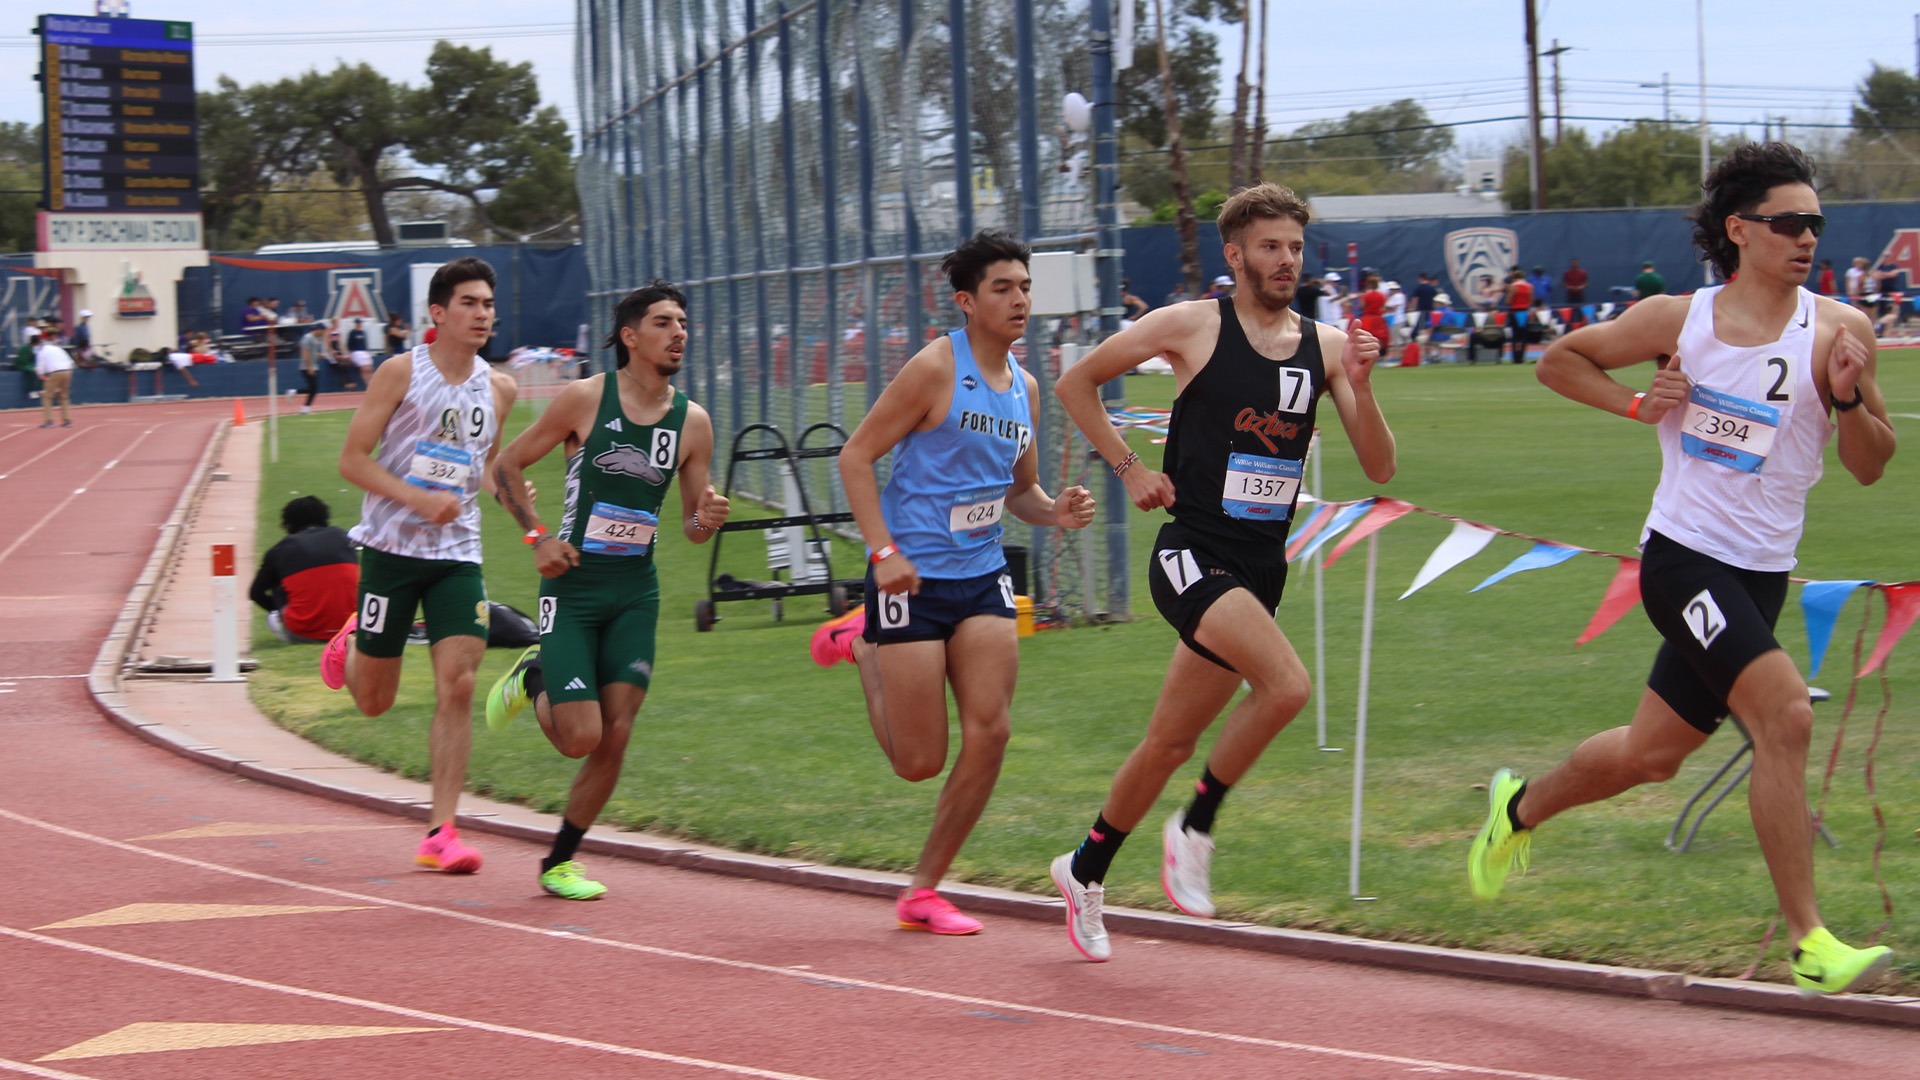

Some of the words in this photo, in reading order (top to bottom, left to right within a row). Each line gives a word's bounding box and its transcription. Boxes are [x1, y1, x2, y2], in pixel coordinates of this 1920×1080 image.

[1286, 370, 1304, 410] 7
[1766, 356, 1789, 402] 2
[470, 406, 484, 438] 9
[960, 410, 995, 435] FORT
[1718, 398, 1748, 411] Williams
[1749, 406, 1773, 419] Classic
[1693, 411, 1749, 442] 2394
[655, 431, 671, 466] 8
[428, 461, 457, 480] 332
[1253, 460, 1278, 470] Williams
[1278, 463, 1298, 473] Classic
[1241, 476, 1286, 497] 1357
[966, 503, 995, 524] 624
[604, 523, 637, 539] 424
[1164, 550, 1187, 588] 7
[365, 597, 381, 629] 9
[541, 598, 551, 632] 8
[884, 593, 903, 625] 6
[1689, 601, 1719, 641] 2
